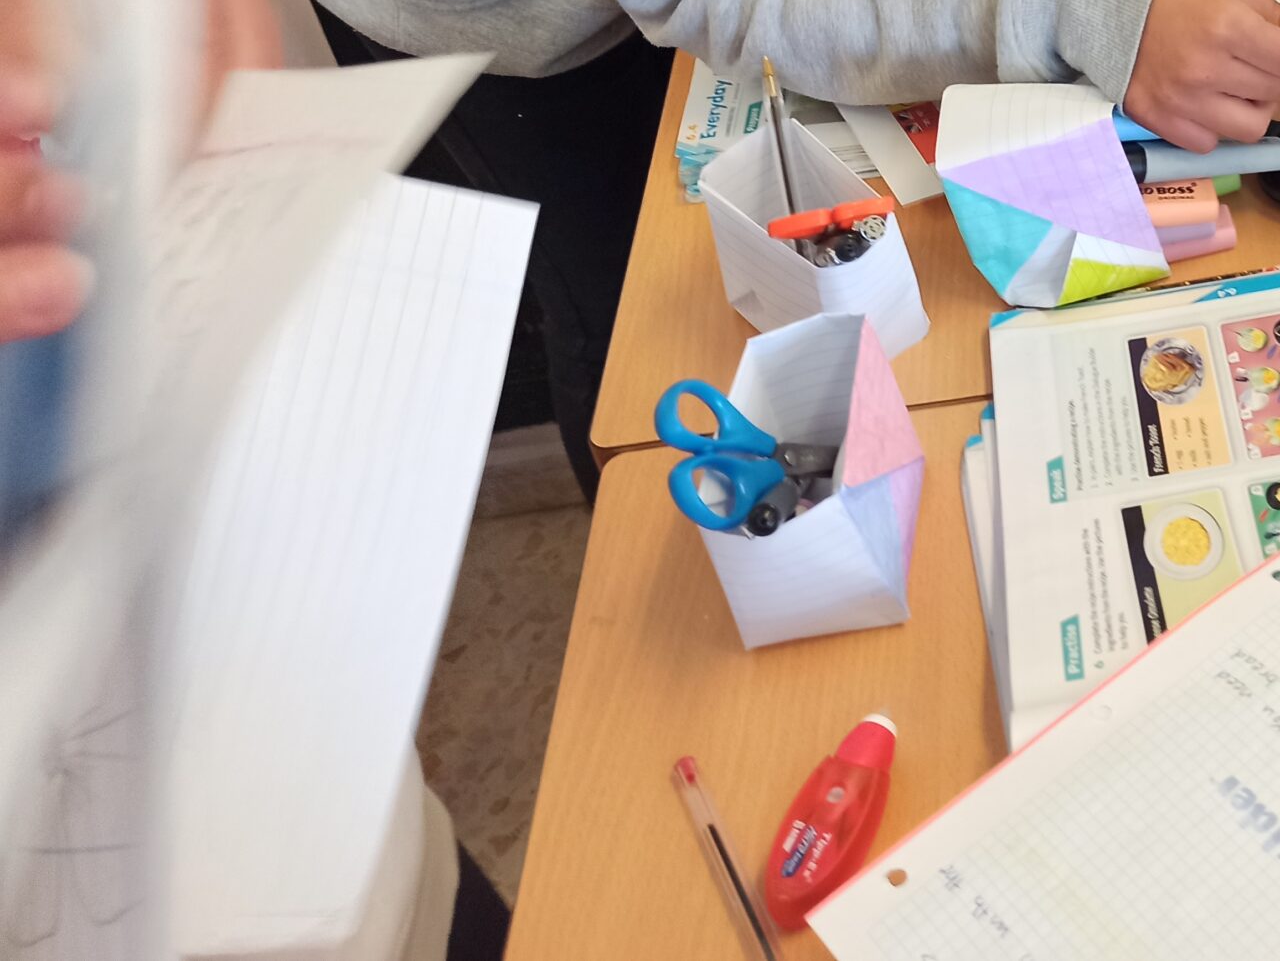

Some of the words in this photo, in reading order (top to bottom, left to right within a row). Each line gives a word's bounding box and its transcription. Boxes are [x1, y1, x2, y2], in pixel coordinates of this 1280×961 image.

[697, 78, 733, 140] Everyday
[1049, 468, 1063, 500] Speak
[1063, 623, 1083, 676] Practise
[1228, 647, 1280, 690] bread
[1213, 669, 1254, 700] need
